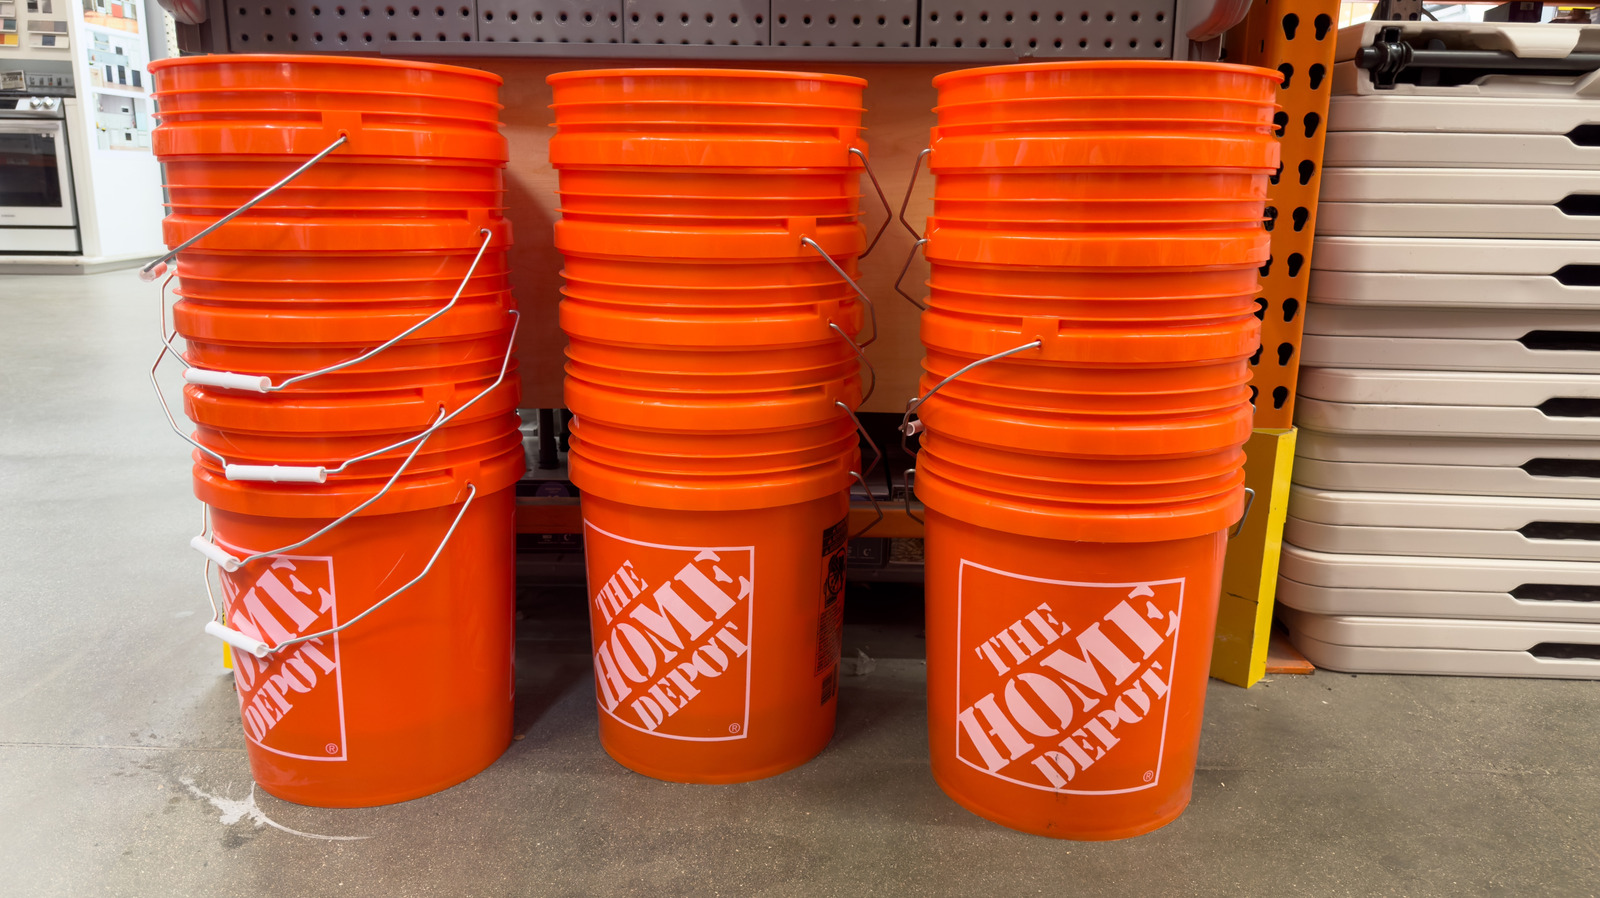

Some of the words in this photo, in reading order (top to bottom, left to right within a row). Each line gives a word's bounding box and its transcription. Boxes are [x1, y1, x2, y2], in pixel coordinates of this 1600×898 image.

[594, 550, 751, 713] HOME
[595, 559, 649, 625] THE
[974, 602, 1072, 677] THE
[244, 637, 336, 743] DEPOT
[630, 621, 748, 732] DEPOT
[959, 584, 1179, 773] HOME
[1030, 660, 1169, 789] DEPOT
